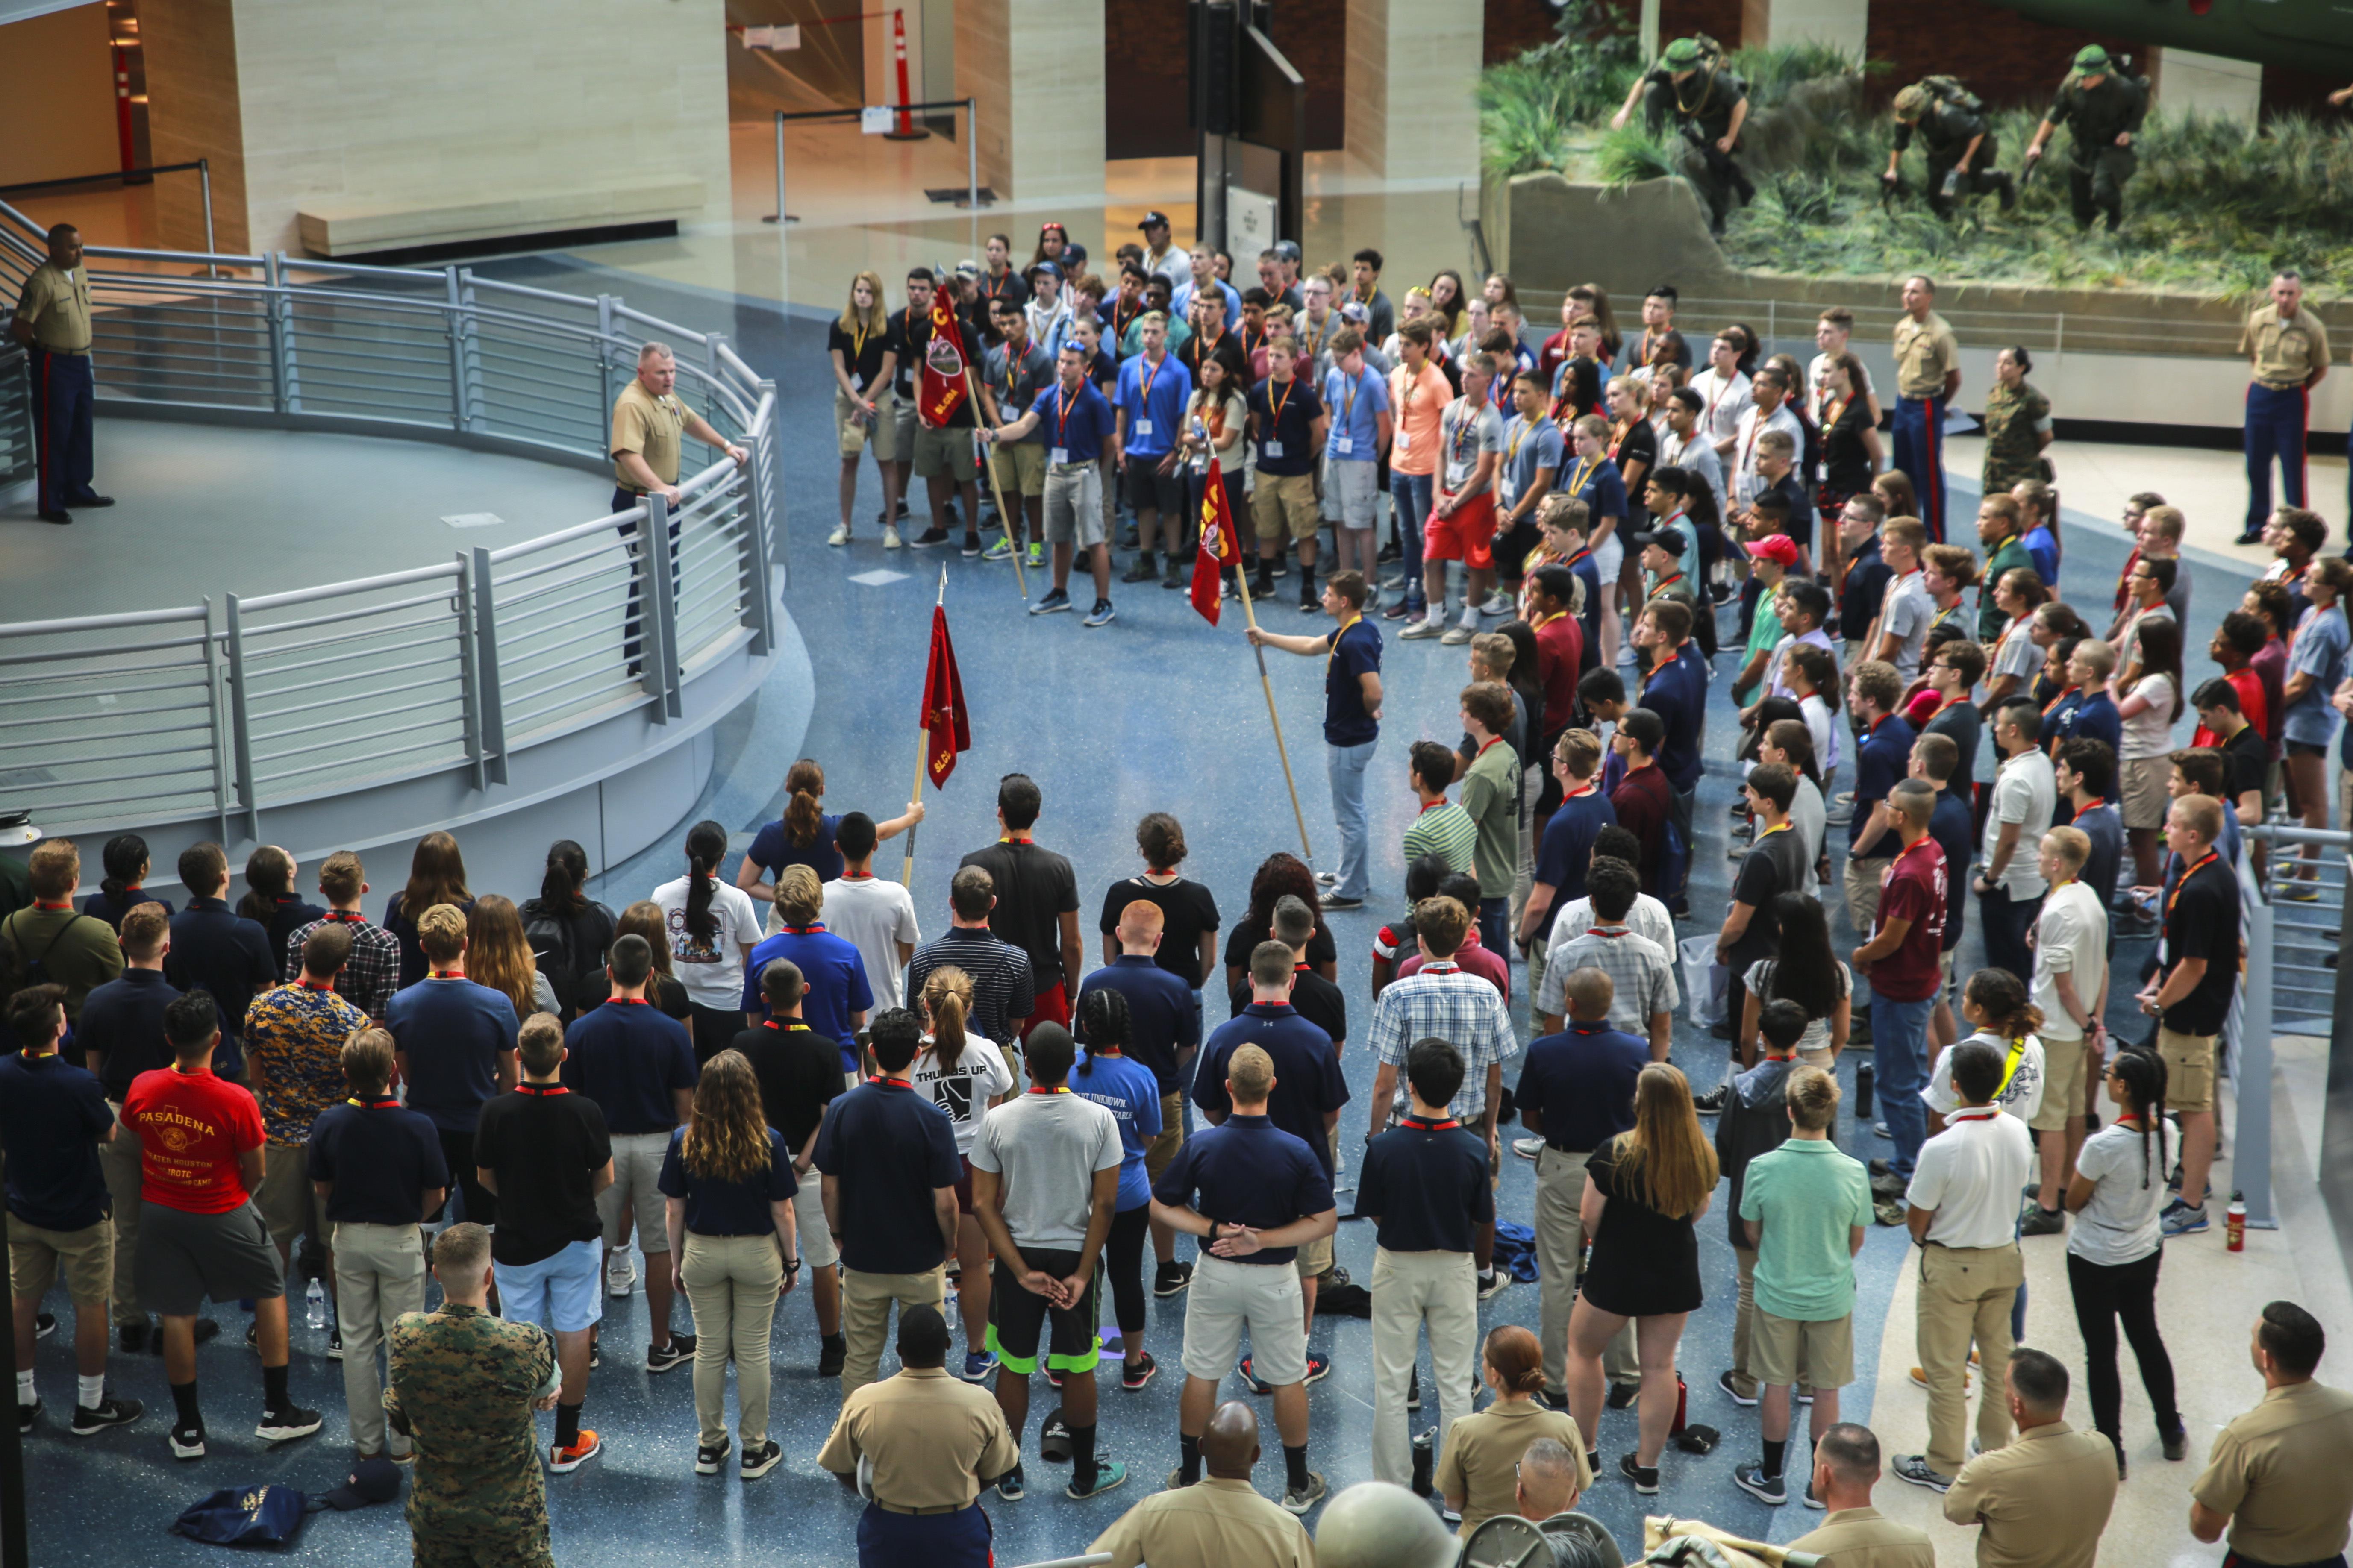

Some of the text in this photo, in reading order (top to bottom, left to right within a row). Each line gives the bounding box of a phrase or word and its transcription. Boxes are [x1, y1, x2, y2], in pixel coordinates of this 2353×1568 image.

[971, 1066, 987, 1075] UP
[1091, 1093, 1126, 1108] UNKNOWN.
[140, 1112, 215, 1136] PASADENA
[174, 1158, 212, 1168] HOUSTON
